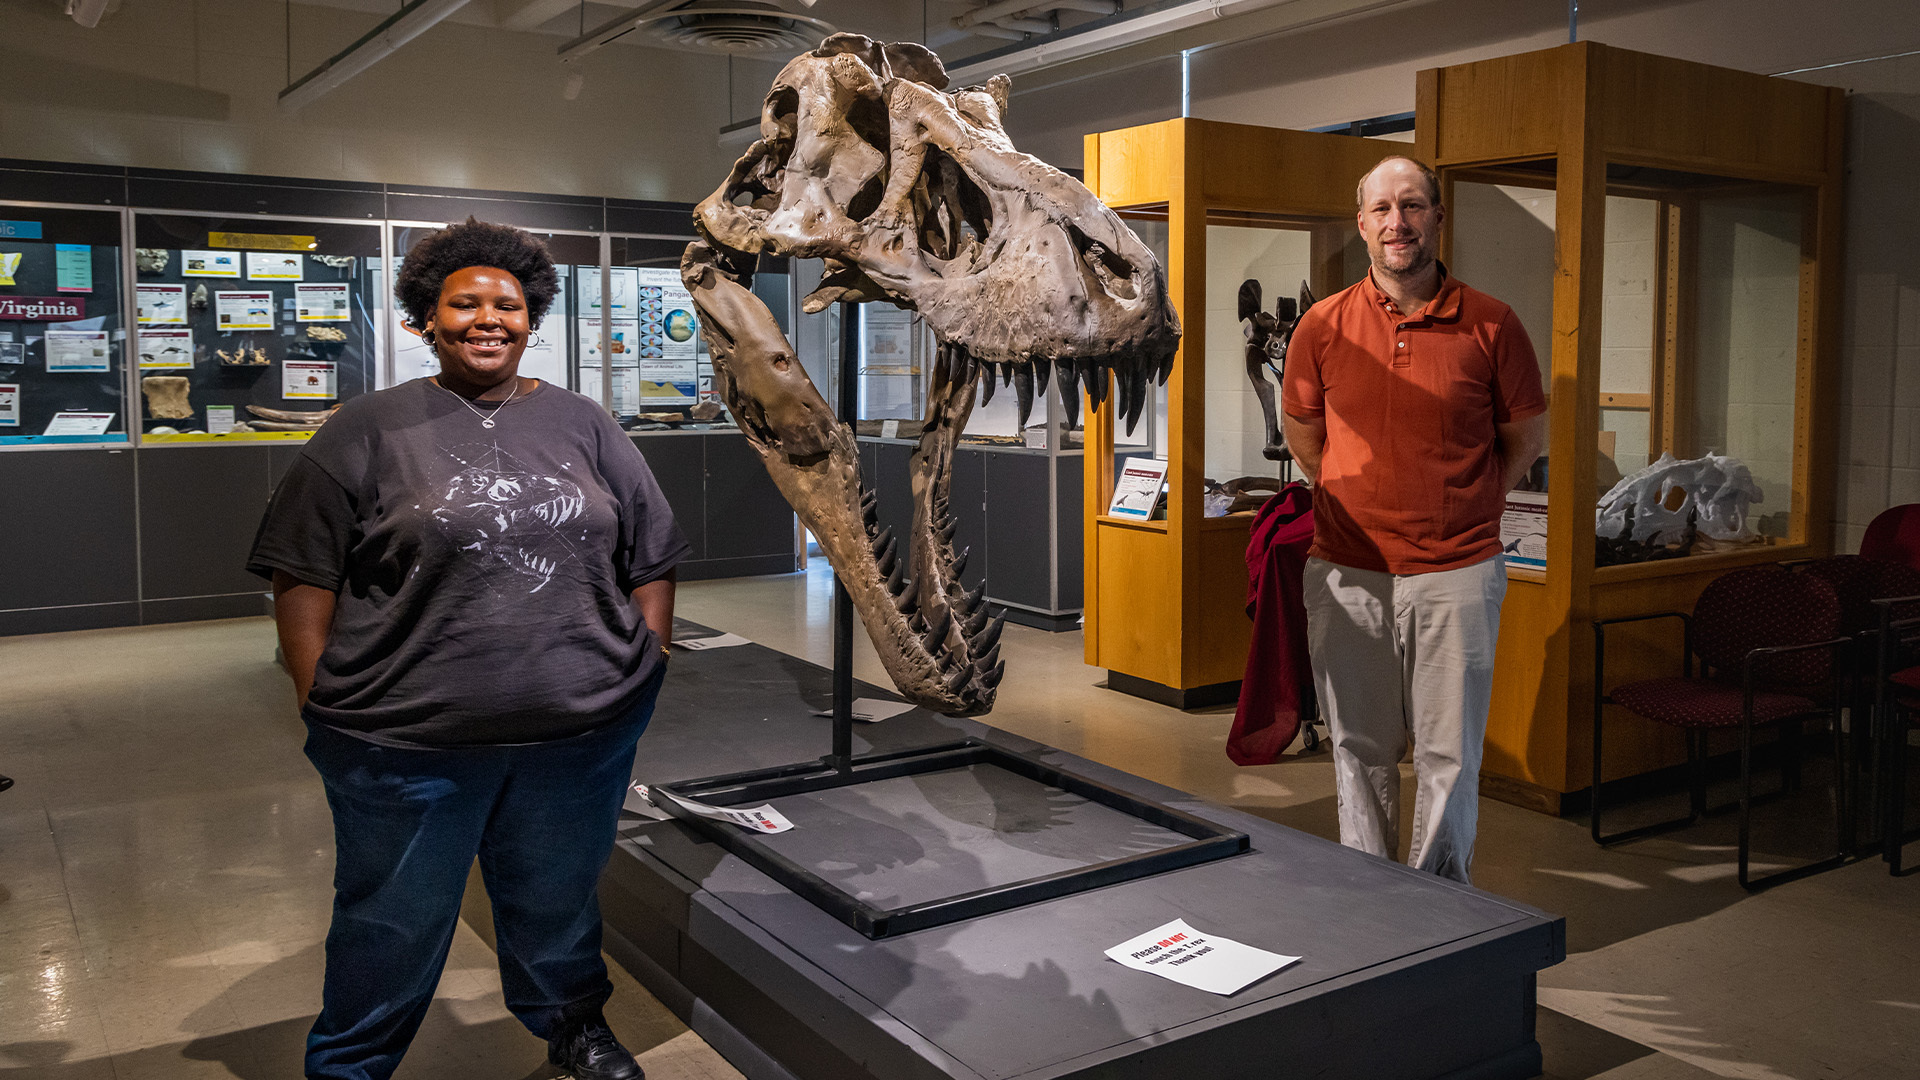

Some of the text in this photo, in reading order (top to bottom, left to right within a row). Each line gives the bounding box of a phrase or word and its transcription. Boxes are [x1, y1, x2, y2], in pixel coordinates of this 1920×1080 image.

[663, 290, 691, 299] Pangae
[1131, 932, 1188, 959] Please DO NOT
[1145, 953, 1173, 965] touch
[1168, 947, 1186, 955] the
[1190, 938, 1206, 947] rex
[1168, 954, 1197, 966] Thank
